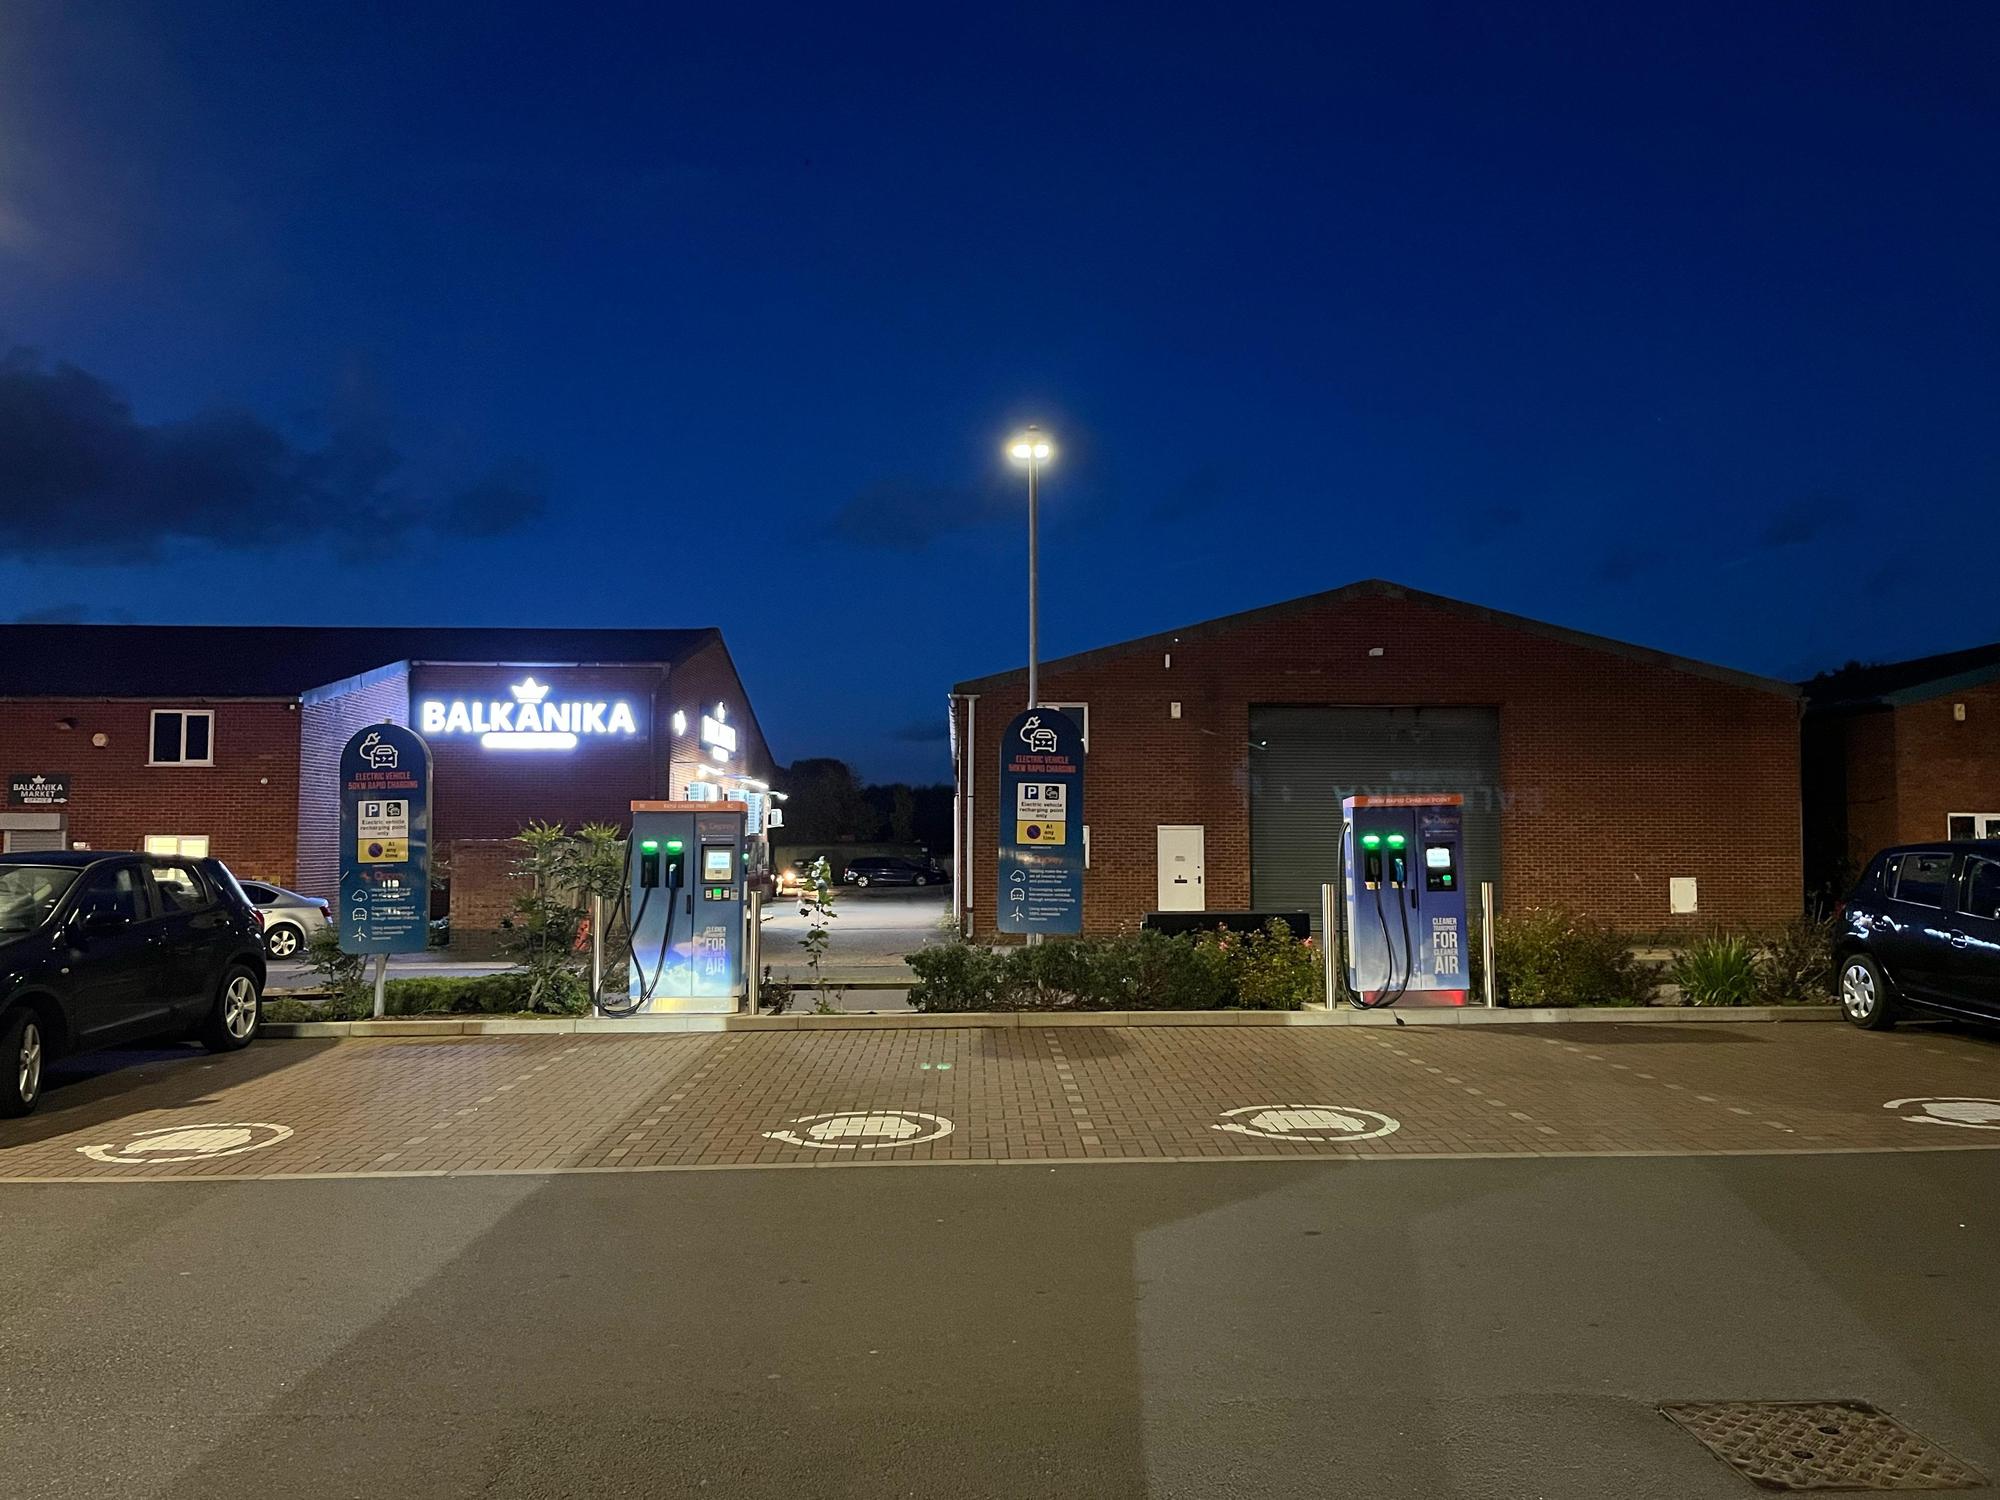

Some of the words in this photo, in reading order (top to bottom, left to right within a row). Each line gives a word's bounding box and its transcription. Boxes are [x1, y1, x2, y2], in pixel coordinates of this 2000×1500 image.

[423, 701, 636, 734] BALKANIKA
[1015, 755, 1044, 764] ELECTRIC
[1045, 755, 1069, 764] VEHICLE
[355, 772, 385, 780] ELECTRIC
[385, 771, 411, 780] VEHICLE
[13, 783, 64, 791] BALKANIKA
[367, 781, 387, 789] RAPID
[20, 790, 56, 798] MARKET
[1027, 787, 1037, 799] P
[368, 804, 378, 817] P
[1432, 917, 1457, 925] CLEANER
[705, 937, 726, 952] FOR
[1432, 931, 1458, 949] FOR
[1433, 948, 1459, 956] CLEANER
[705, 957, 726, 976] AIR
[1434, 955, 1459, 975] AIR
